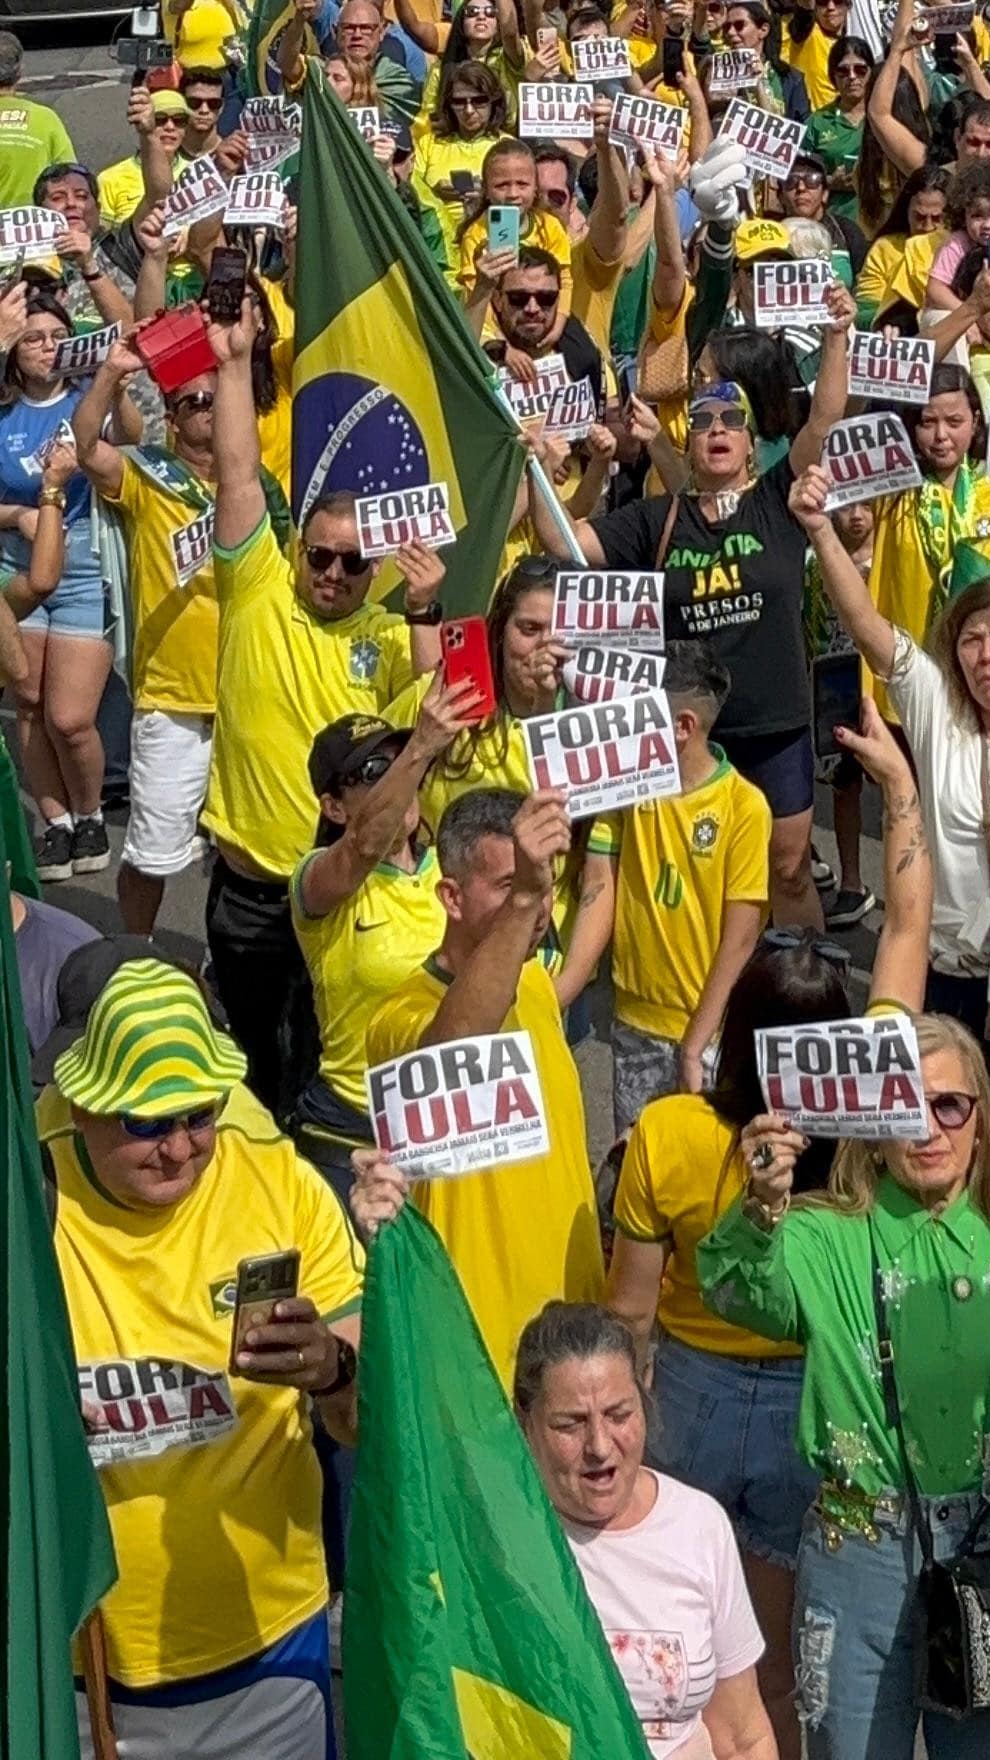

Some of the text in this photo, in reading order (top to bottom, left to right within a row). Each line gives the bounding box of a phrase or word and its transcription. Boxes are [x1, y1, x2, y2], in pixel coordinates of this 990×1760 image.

[574, 39, 627, 56] FORA
[575, 52, 628, 72] LULA
[523, 86, 590, 102] FORA
[522, 102, 590, 121] LULA
[617, 95, 683, 128] FORA
[729, 102, 802, 145] FORA
[612, 113, 679, 146] LULA
[233, 174, 280, 192] FOR
[759, 263, 832, 284] FORA
[58, 324, 120, 357] FORA
[853, 336, 931, 363] FORA
[851, 356, 928, 386] LULA
[326, 388, 385, 456] PROGRESSO
[828, 419, 905, 457] ORA
[830, 445, 911, 483] ULA
[359, 486, 447, 524] FORA
[361, 511, 450, 550] LULA
[559, 575, 659, 602] FORA
[693, 561, 741, 598] JÁ!
[555, 602, 659, 631] LULA
[680, 592, 763, 620] PRESOS
[696, 620, 712, 632] DE
[713, 609, 760, 629] JANEIRO
[576, 646, 657, 680] ORA
[527, 695, 667, 756] FORA
[534, 731, 673, 785] LULA
[766, 1033, 916, 1075] FORA
[370, 1037, 531, 1114] FORA
[767, 1073, 920, 1113] LULA
[376, 1077, 539, 1153] LULA
